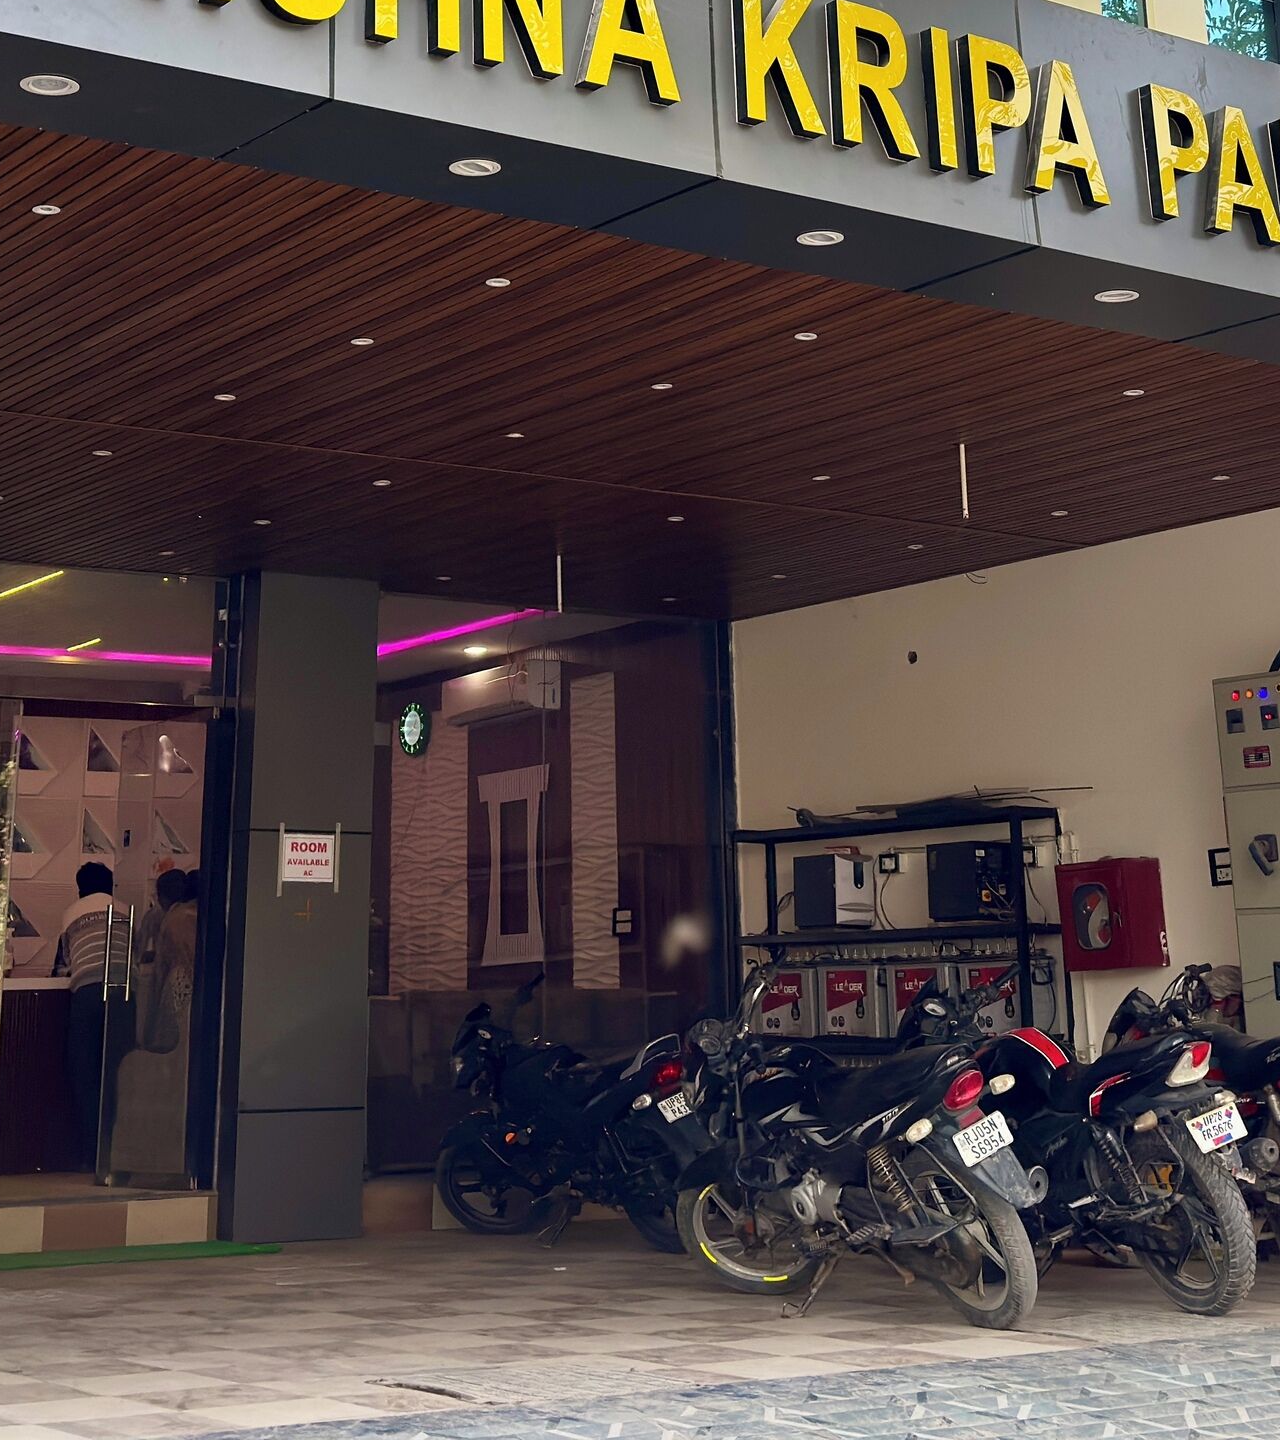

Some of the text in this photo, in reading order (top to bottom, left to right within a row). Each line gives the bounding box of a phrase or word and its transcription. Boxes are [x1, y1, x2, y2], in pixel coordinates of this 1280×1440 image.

[290, 841, 327, 853] ROOM
[287, 858, 330, 866] AVAILABLE
[962, 1117, 999, 1146] RJ05N
[971, 1131, 1006, 1158] S6954
